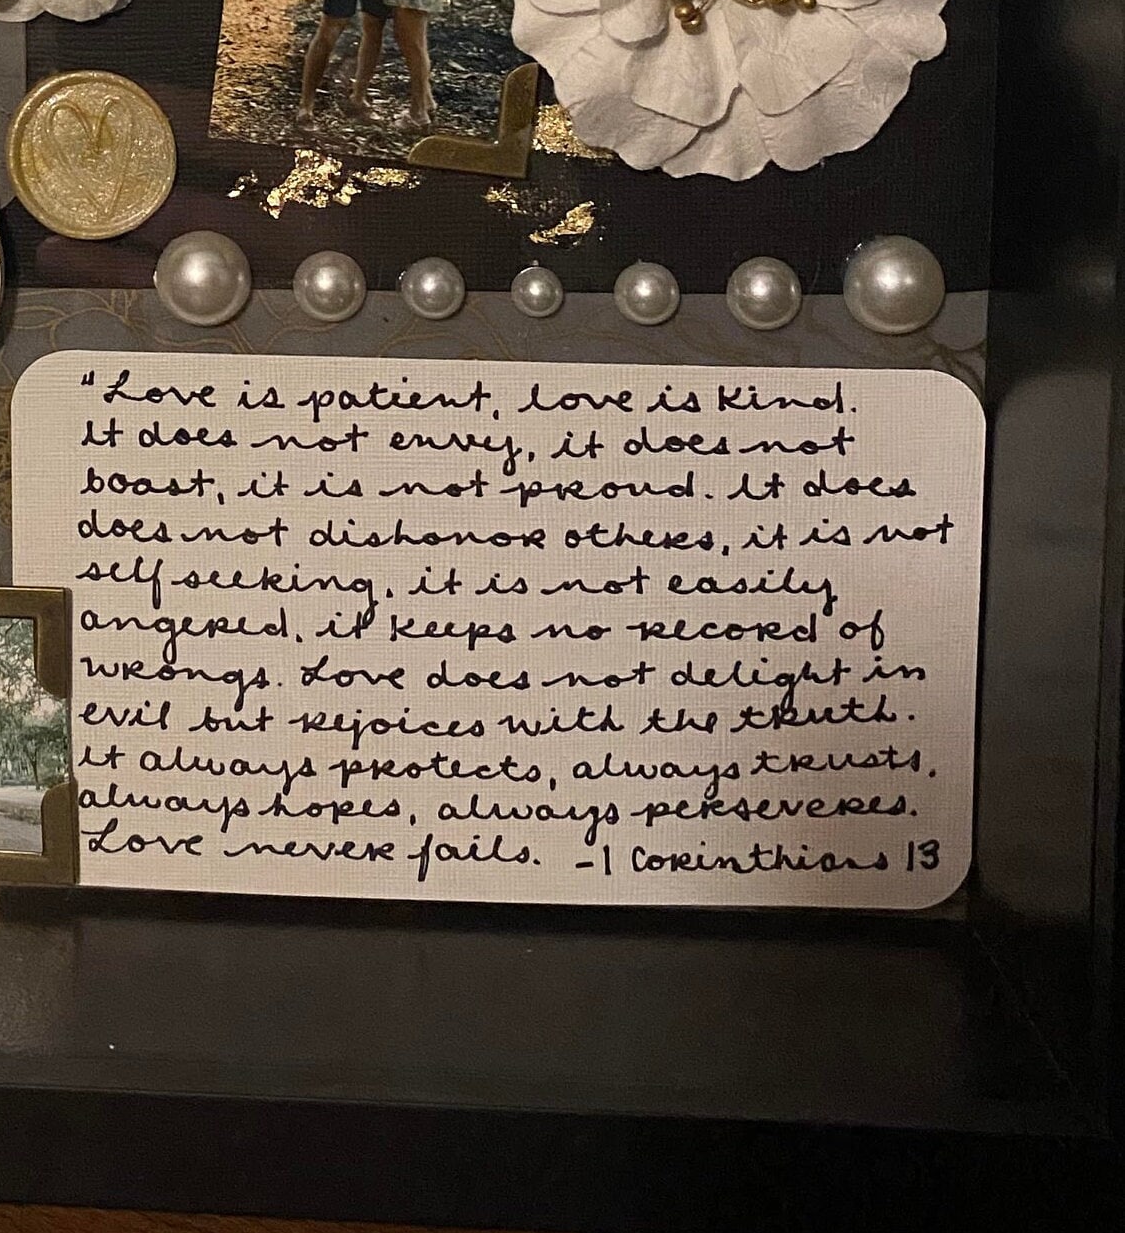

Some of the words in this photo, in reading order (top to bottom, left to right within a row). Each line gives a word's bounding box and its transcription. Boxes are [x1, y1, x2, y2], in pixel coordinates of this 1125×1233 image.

[237, 380, 286, 410] is
[517, 382, 634, 414] love
[646, 385, 702, 414] is
[138, 421, 238, 449] does
[251, 424, 369, 453] not
[389, 428, 536, 476] envy,
[551, 430, 605, 459] it
[623, 426, 731, 457] does
[739, 426, 855, 456] not
[80, 467, 225, 505] boast,
[237, 470, 289, 498] it
[304, 471, 364, 498] is
[378, 470, 489, 498] not
[500, 470, 714, 508] proud.
[802, 469, 917, 498] does
[77, 509, 173, 543] does
[180, 517, 289, 547] not
[309, 518, 547, 547] dishonor
[564, 521, 730, 556] others,
[742, 523, 788, 550] it
[799, 518, 852, 547] is
[863, 513, 955, 545] not
[76, 556, 164, 610] self
[408, 567, 462, 596] it
[475, 572, 528, 596] is
[540, 565, 650, 596] not
[667, 567, 839, 617] easily
[315, 610, 369, 639] it
[531, 620, 613, 641] no
[626, 612, 817, 643] record
[838, 609, 886, 651] of
[80, 656, 283, 712] wrongs.
[301, 655, 406, 690] Love
[426, 660, 531, 690] does
[542, 661, 656, 690] not
[670, 657, 852, 710] delight
[863, 656, 927, 683] in
[78, 701, 172, 730] evil
[189, 706, 274, 733] but
[289, 707, 486, 750] rejoices
[498, 705, 625, 736] with
[639, 708, 719, 735] the
[730, 695, 917, 734] truth.
[140, 745, 317, 794] always
[329, 752, 557, 791] protects,
[573, 753, 741, 800] always
[78, 783, 251, 833] always
[258, 792, 416, 825] hopes,
[437, 794, 620, 846] always
[630, 794, 919, 827] perseveres.
[81, 818, 205, 856] Love
[224, 838, 396, 862] never
[407, 833, 542, 882] fails.
[631, 841, 889, 874] Corinthians
[907, 840, 942, 871] 13
